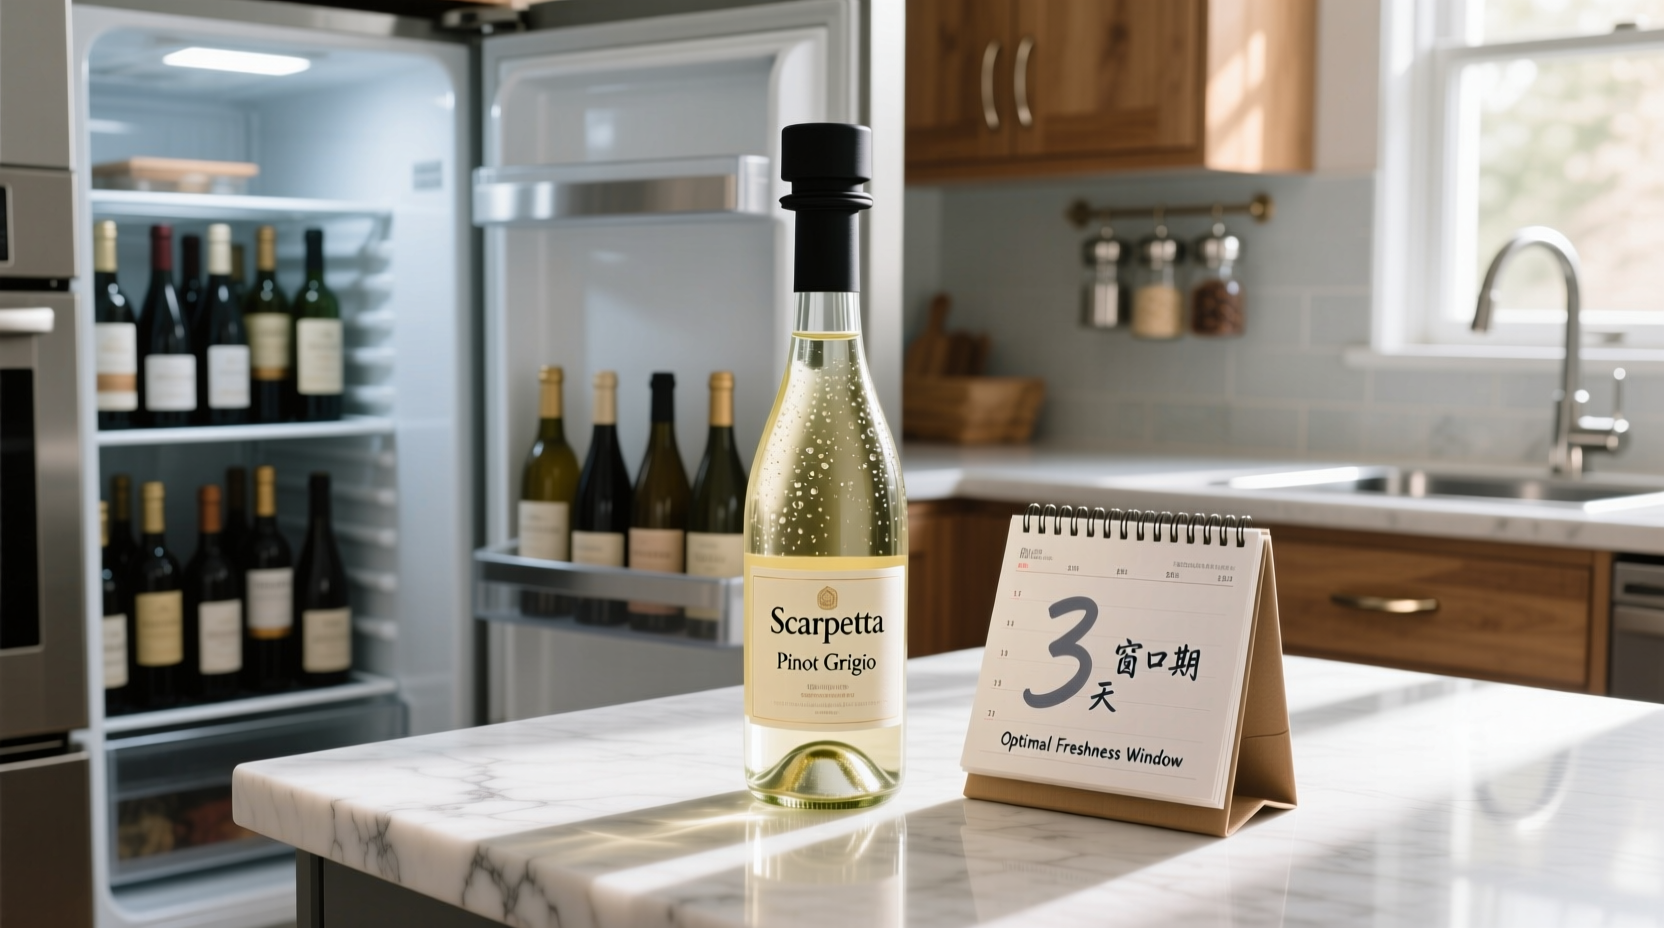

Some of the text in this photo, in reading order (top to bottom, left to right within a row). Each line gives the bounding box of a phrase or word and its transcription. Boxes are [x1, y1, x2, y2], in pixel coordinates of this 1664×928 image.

[771, 606, 884, 644] Scarpetta
[777, 652, 876, 676] Pinot Grigio
[1023, 596, 1099, 709] 3
[1115, 638, 1201, 681] 窗口期
[1089, 681, 1116, 712] 天
[1001, 731, 1183, 768] Optimal Freshness Window
